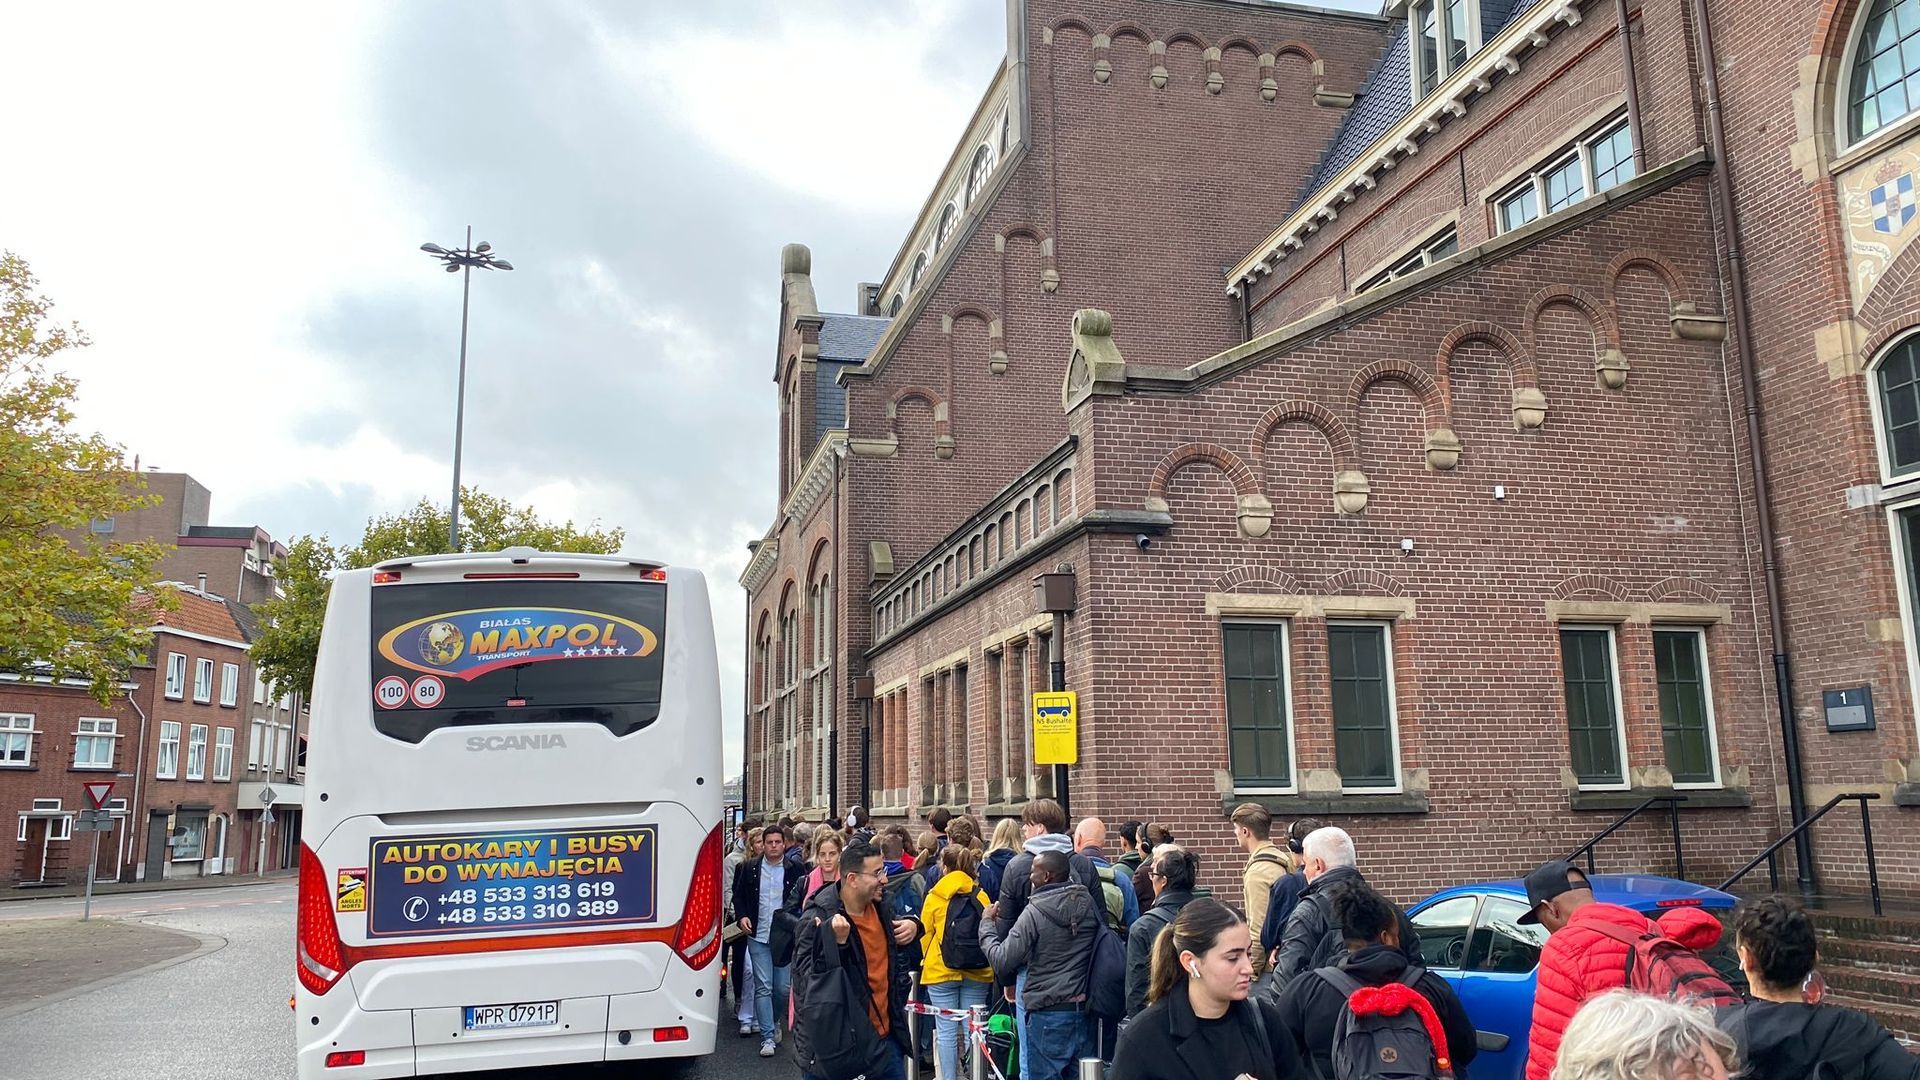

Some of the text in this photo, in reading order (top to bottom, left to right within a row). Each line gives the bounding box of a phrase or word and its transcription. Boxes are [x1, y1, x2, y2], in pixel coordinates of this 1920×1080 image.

[480, 617, 531, 629] BIAŁAS
[469, 622, 619, 656] MAXPOL
[477, 650, 531, 661] TRANSPORT
[380, 686, 404, 698] 100
[419, 686, 436, 697] 80
[1839, 691, 1847, 705] 1
[466, 734, 567, 752] SCANIA
[382, 834, 645, 864] AUTOKARY I BUSY
[404, 856, 623, 884] DO WYNAJĘCIA
[438, 881, 615, 906] +48 533 313 619
[438, 899, 619, 924] +48 533 310 389
[475, 1007, 504, 1025] WPR
[509, 1004, 555, 1022] 0791P
